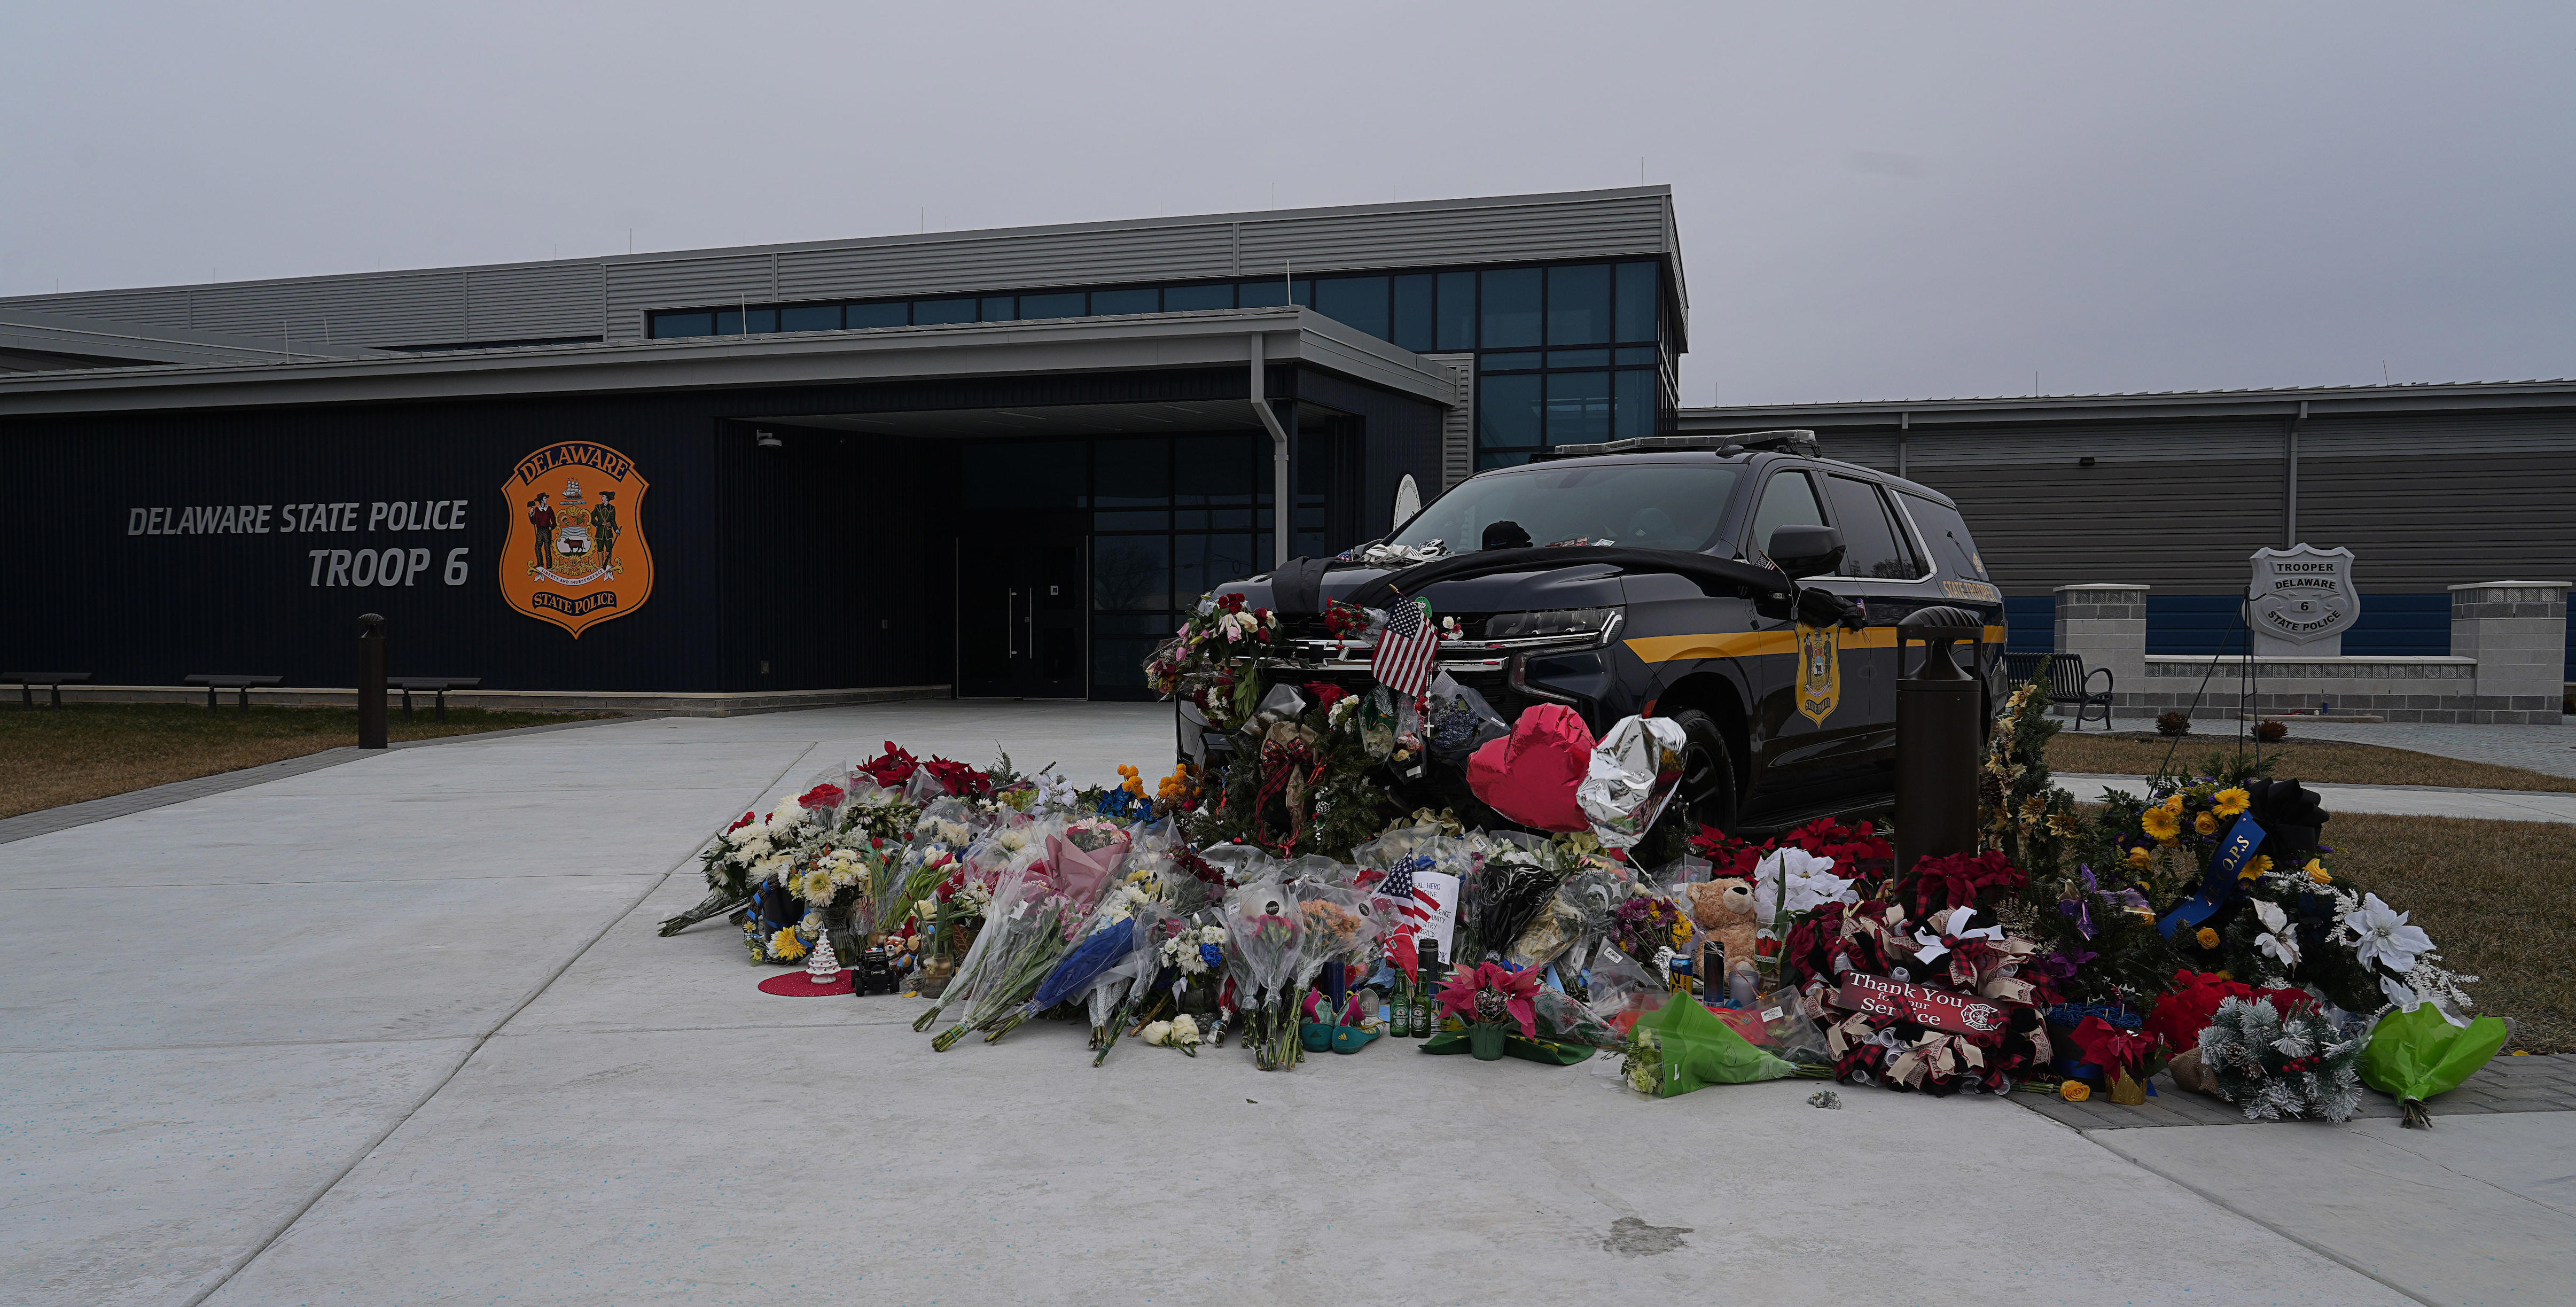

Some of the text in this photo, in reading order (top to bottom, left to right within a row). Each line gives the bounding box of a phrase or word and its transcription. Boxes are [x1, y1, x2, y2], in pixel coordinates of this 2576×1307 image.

[521, 446, 628, 483] DELAWARE
[128, 500, 468, 535] DELAWARE STATE POLICE
[308, 547, 469, 587] TROOP 6
[541, 569, 559, 581] LIBERTY
[571, 570, 604, 585] INDEPENDENCE
[1943, 581, 1997, 601] STATE TROOPER
[2275, 579, 2336, 589] DELAWARE
[534, 594, 614, 614] STATE POLICE
[2300, 602, 2309, 611] 6
[2268, 610, 2341, 631] STATE POLICE
[1806, 698, 1830, 714] STATE POLICE
[1426, 883, 1441, 891] HERO
[1850, 972, 1963, 1008] Thank You
[1861, 998, 1941, 1025] Serce
[1909, 1000, 1930, 1010] our
